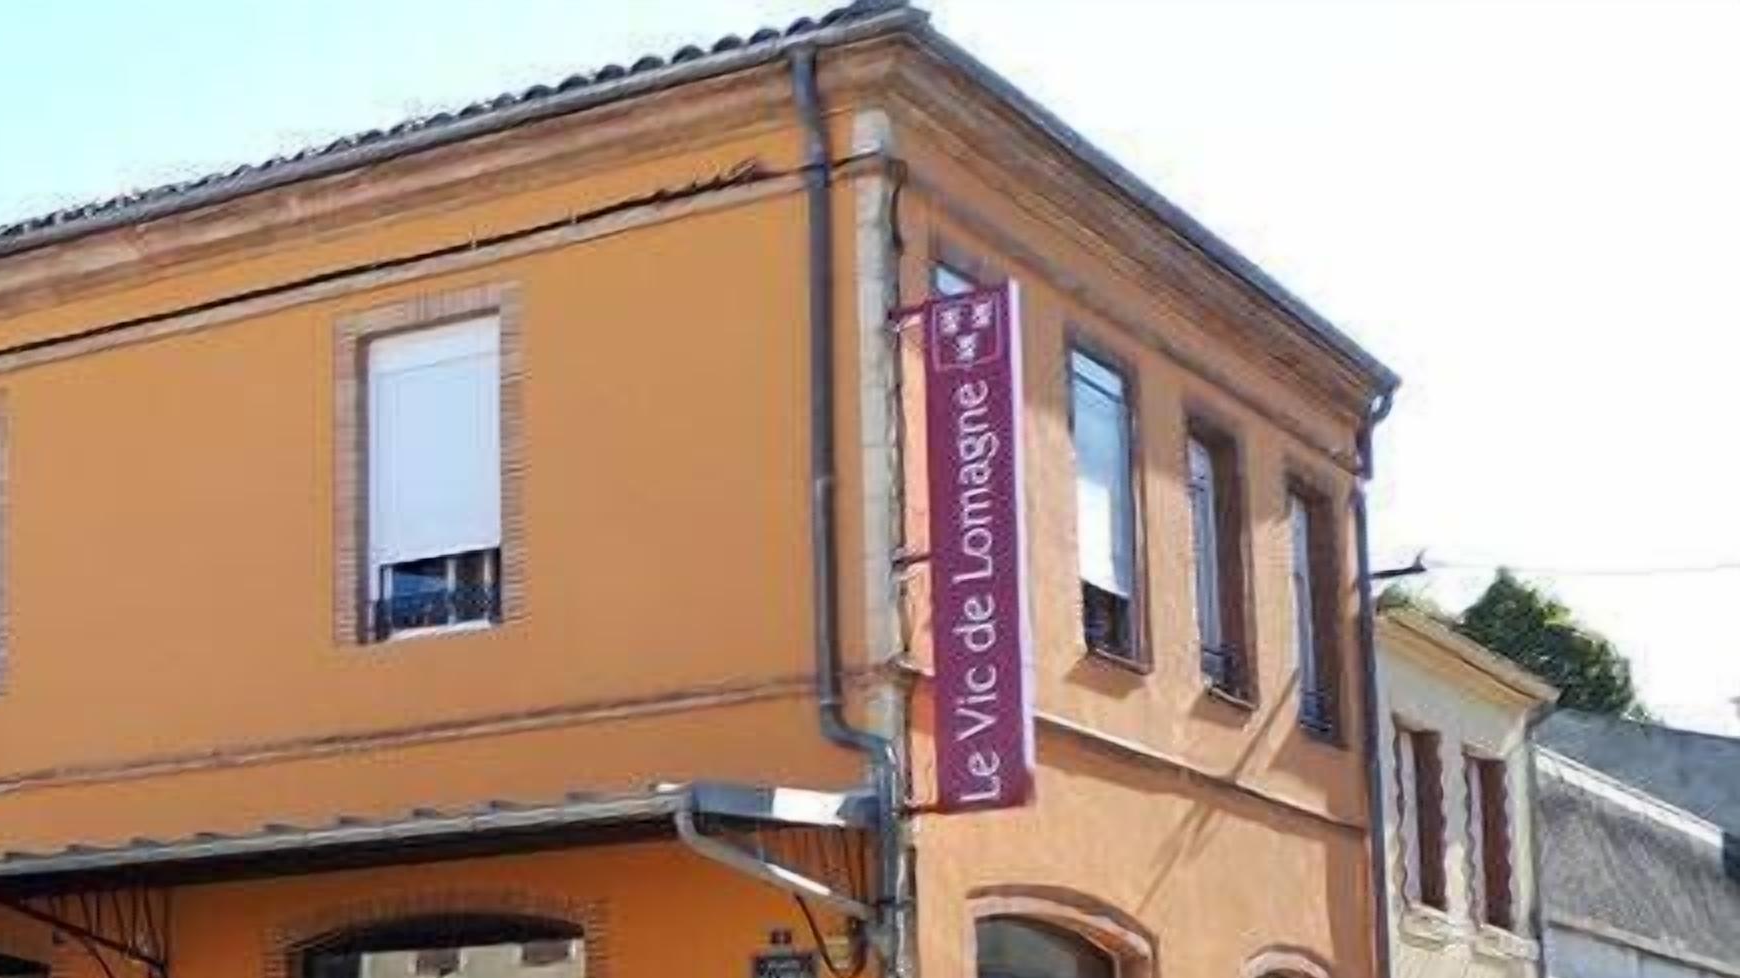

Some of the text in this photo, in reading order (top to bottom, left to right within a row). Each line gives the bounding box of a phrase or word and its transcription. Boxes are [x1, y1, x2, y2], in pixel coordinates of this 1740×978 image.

[951, 380, 1001, 801] Le Vic de Lomagne
